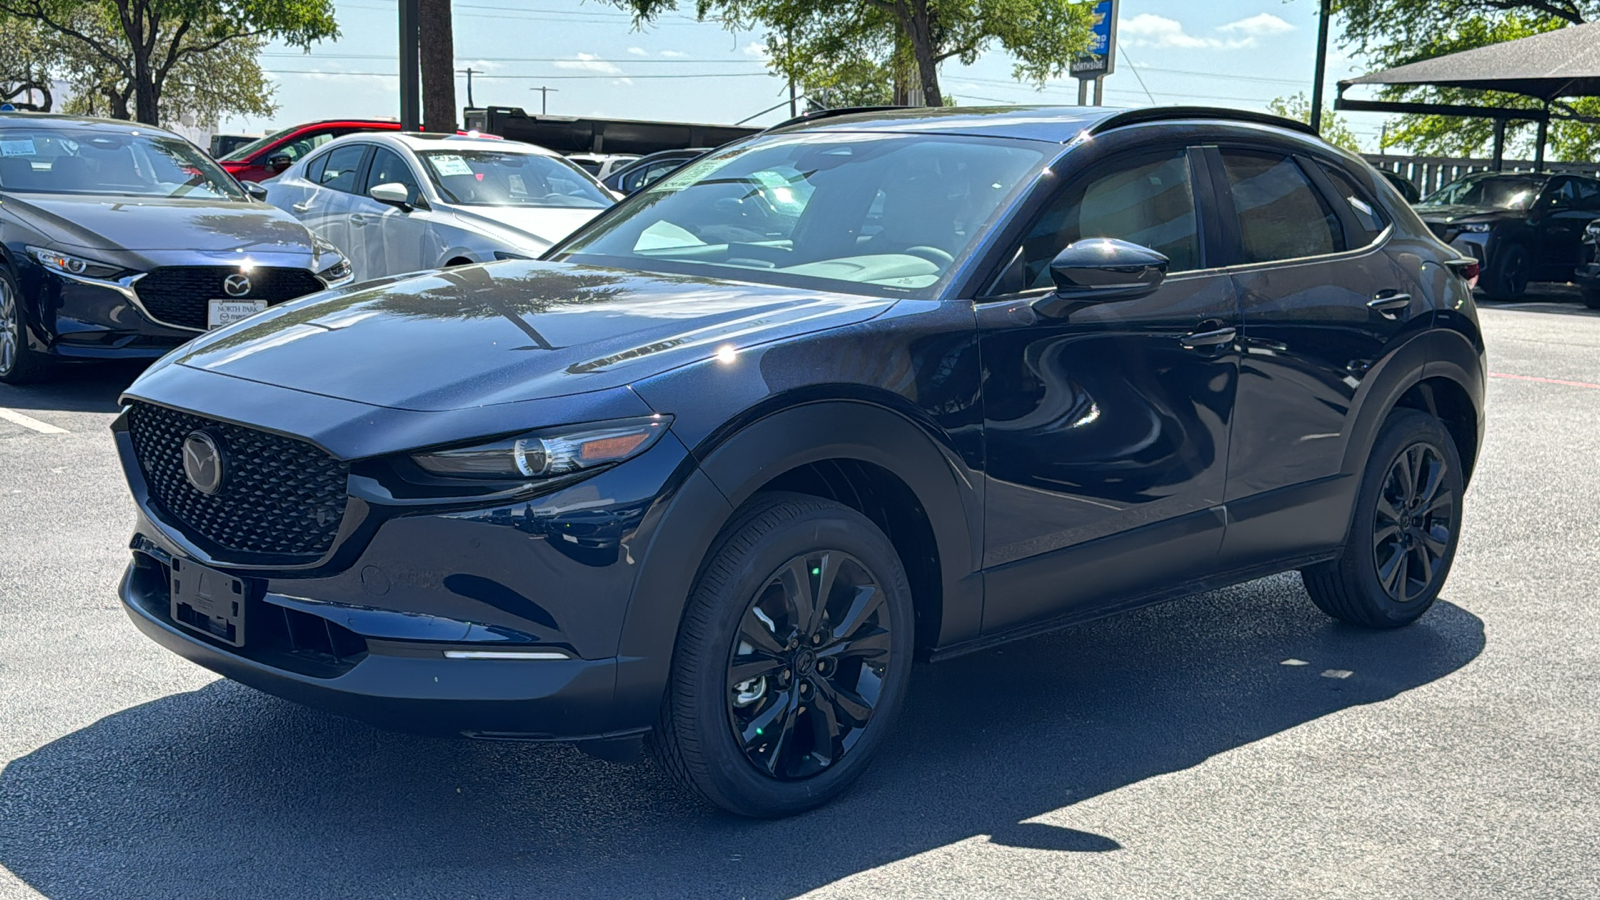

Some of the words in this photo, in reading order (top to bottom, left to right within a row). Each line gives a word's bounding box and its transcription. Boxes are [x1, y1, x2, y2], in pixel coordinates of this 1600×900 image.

[1073, 60, 1103, 71] NORTHSIDE
[217, 305, 241, 313] NORTH
[242, 305, 258, 313] PARK
